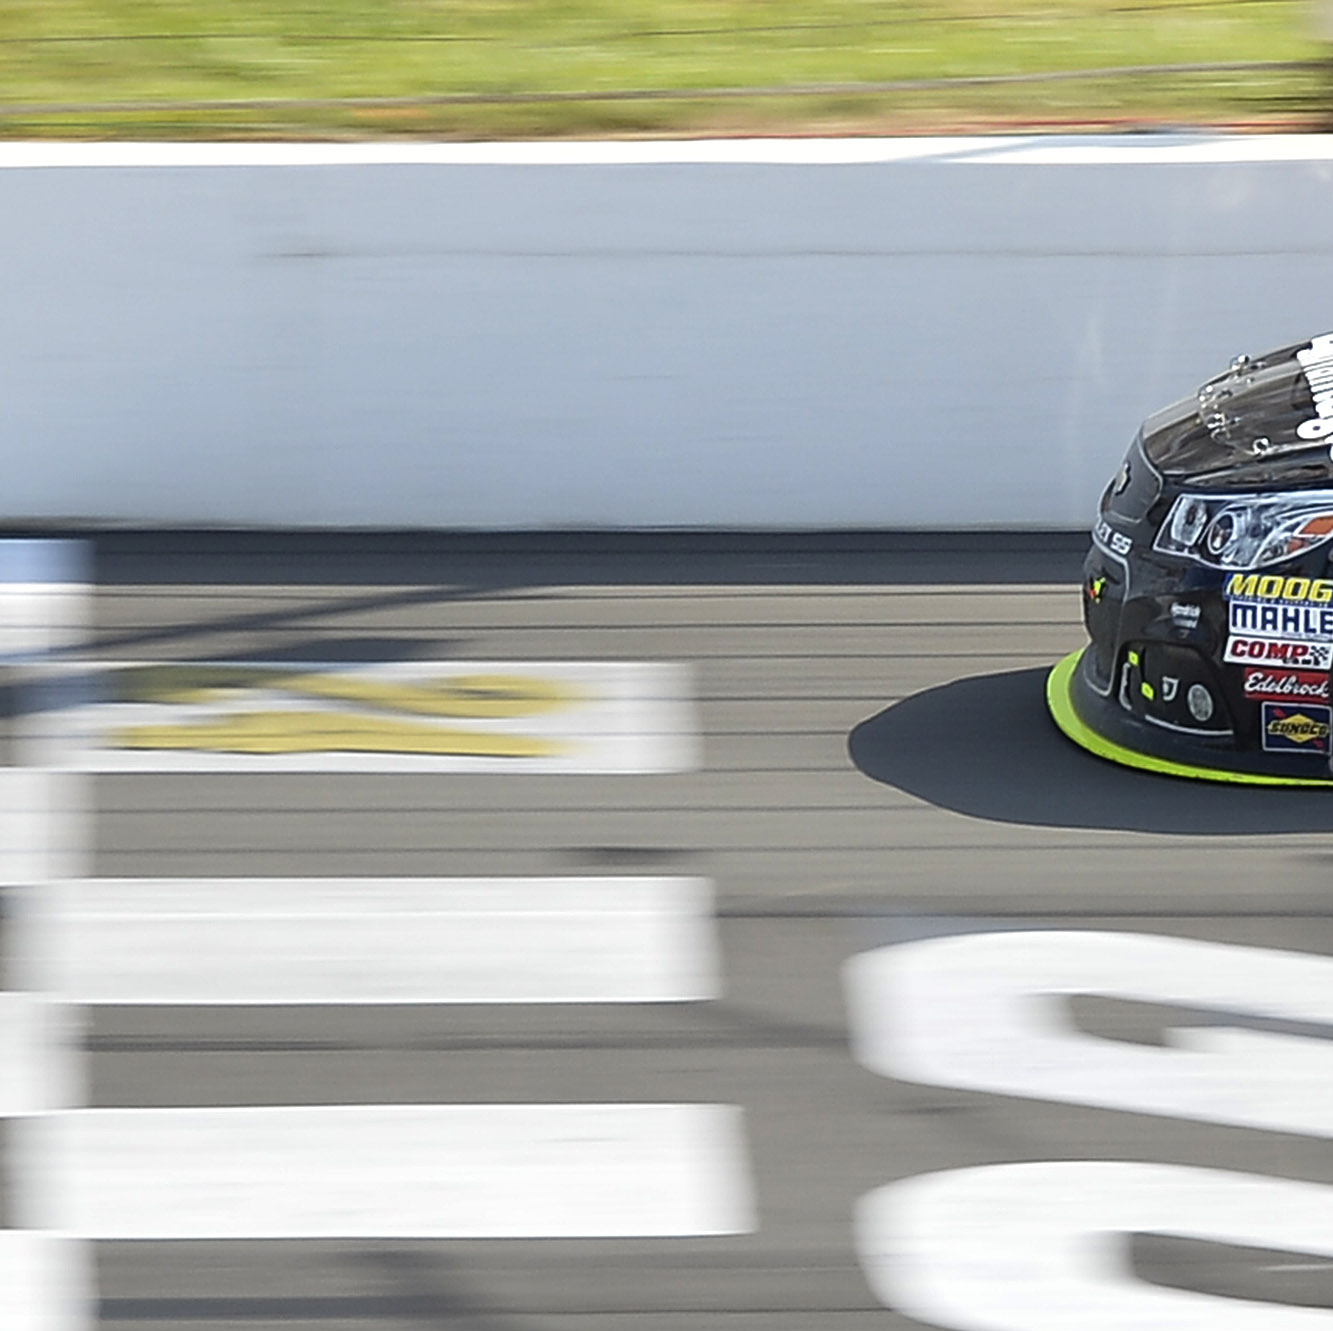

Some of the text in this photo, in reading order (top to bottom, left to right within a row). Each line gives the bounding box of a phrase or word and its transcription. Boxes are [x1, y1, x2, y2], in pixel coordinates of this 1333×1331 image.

[1230, 639, 1310, 661] COMP
[1243, 671, 1331, 698] Edelbrock
[1268, 720, 1330, 737] SUNOCO
